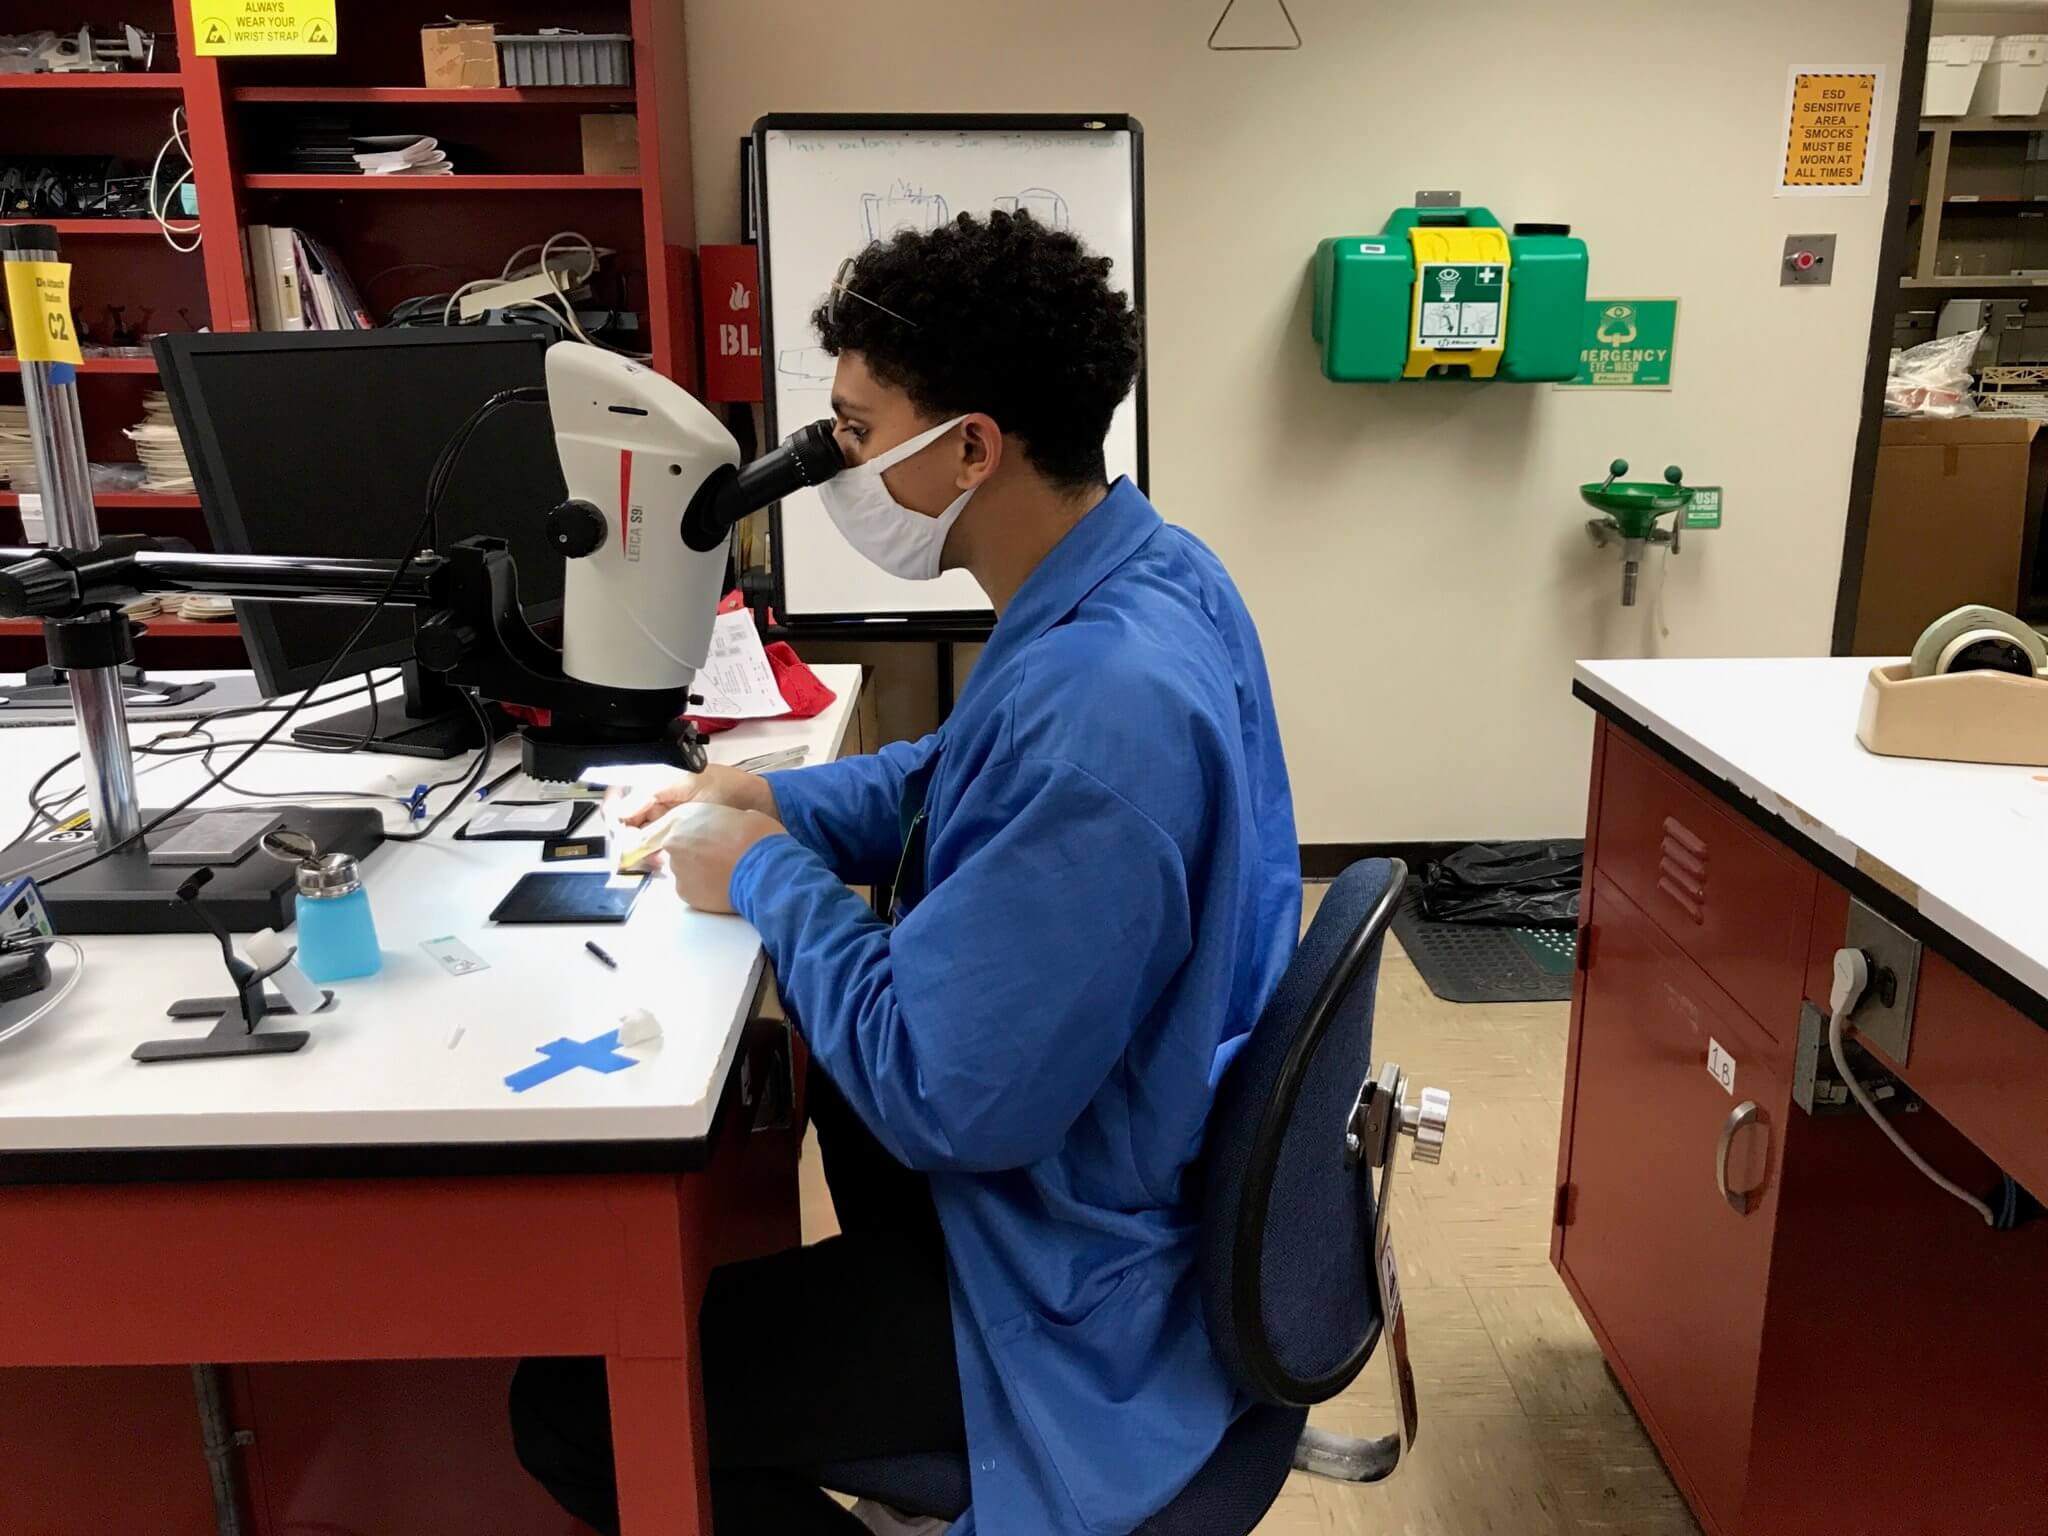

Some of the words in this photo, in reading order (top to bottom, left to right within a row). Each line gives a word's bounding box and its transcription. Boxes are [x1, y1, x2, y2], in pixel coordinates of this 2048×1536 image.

[245, 2, 285, 13] ALWAYS
[236, 16, 268, 28] WEAR
[269, 16, 295, 28] YOUR
[234, 31, 264, 42] WRIST
[267, 31, 299, 42] STRAP
[1822, 89, 1846, 99] ESD
[1803, 102, 1862, 112] SENSITIVE
[1814, 115, 1846, 125] AREA
[1804, 128, 1854, 139] SMOCKS
[1802, 142, 1834, 152] MUST
[1836, 142, 1853, 152] BE
[1799, 155, 1835, 165] WORN
[1836, 155, 1853, 165] AT
[1794, 167, 1816, 178] ALL
[1820, 167, 1853, 178] TIMES
[48, 312, 70, 341] C2
[719, 323, 762, 356] BL
[1580, 349, 1667, 362] MERGENCY
[1693, 491, 1719, 505] USH
[628, 527, 643, 562] LEICA
